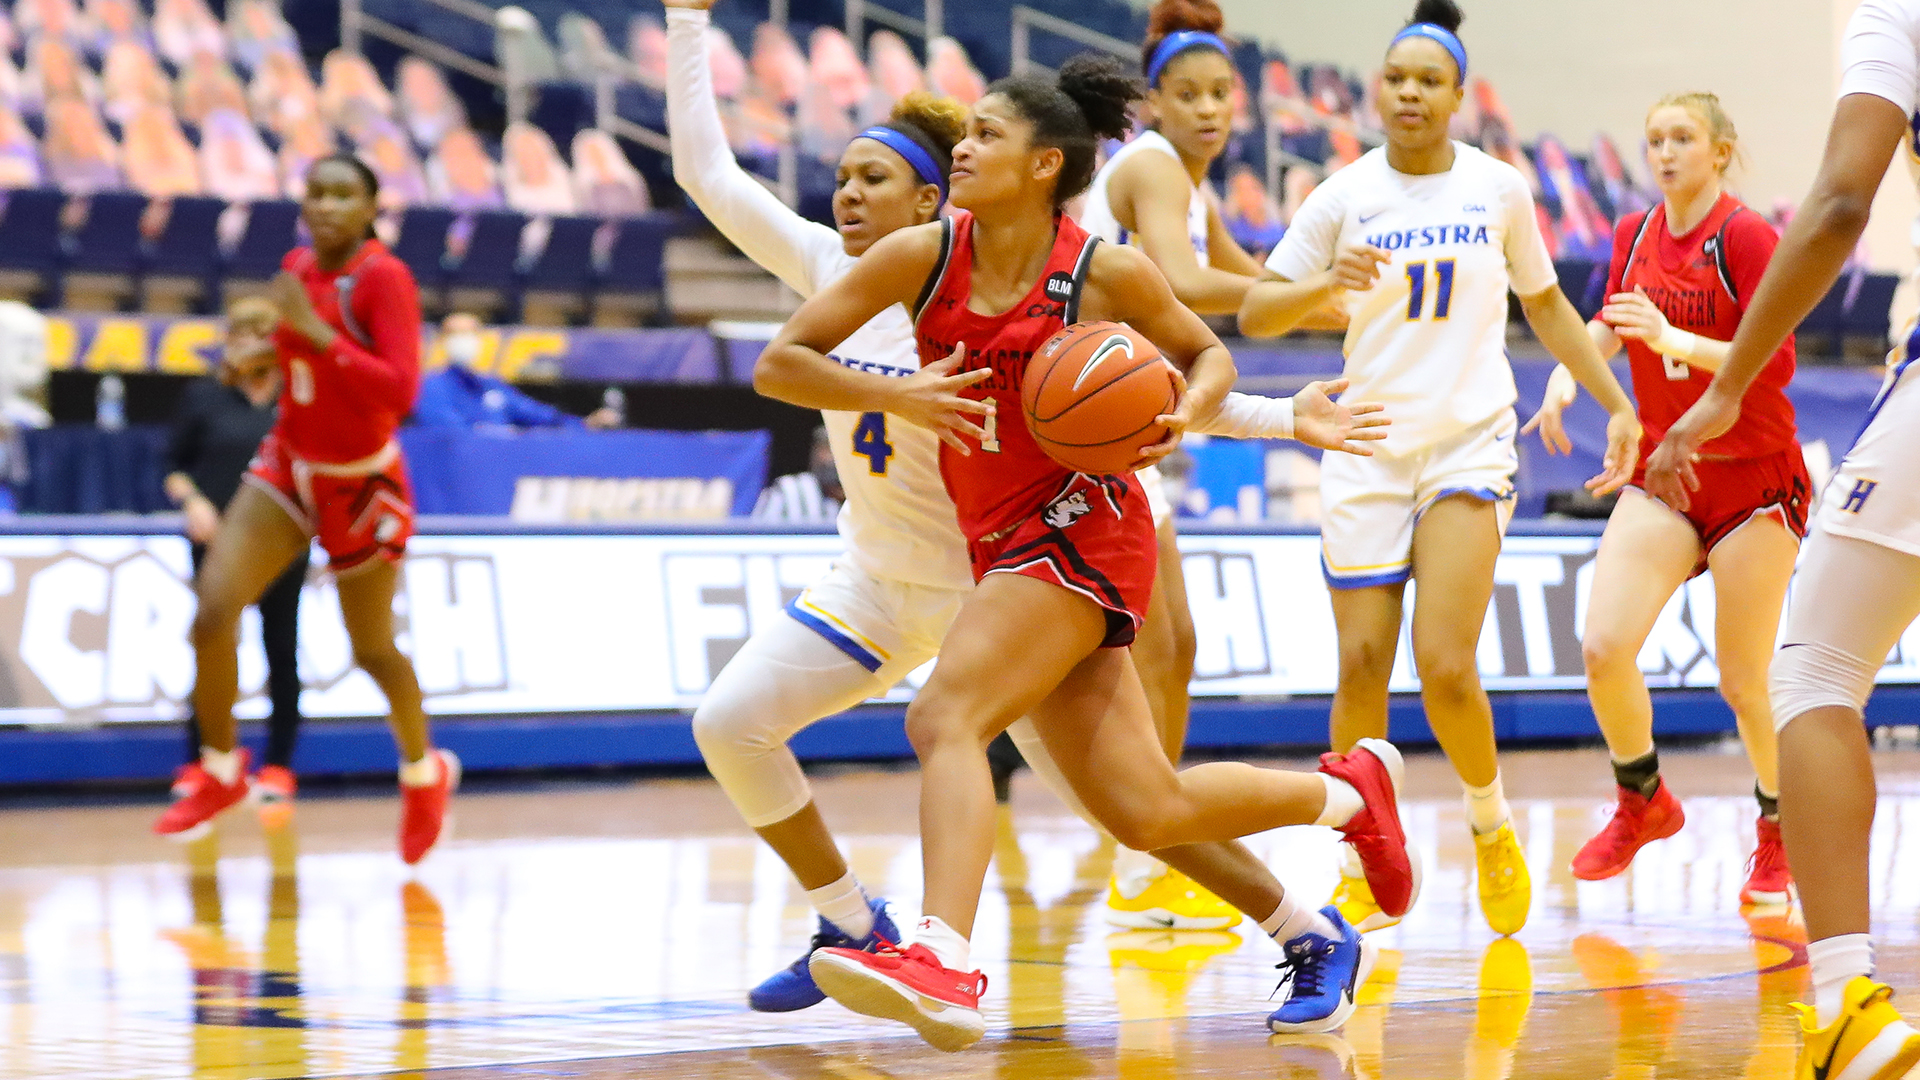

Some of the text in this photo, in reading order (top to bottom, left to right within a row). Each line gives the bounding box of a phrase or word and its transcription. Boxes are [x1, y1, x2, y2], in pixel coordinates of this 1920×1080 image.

[1462, 203, 1487, 213] CAA
[1366, 223, 1489, 251] HOFSTRA
[1047, 278, 1073, 296] BLM
[1405, 256, 1457, 322] 11
[851, 410, 895, 478] 4
[981, 396, 1000, 454] 1
[1838, 476, 1880, 515] H
